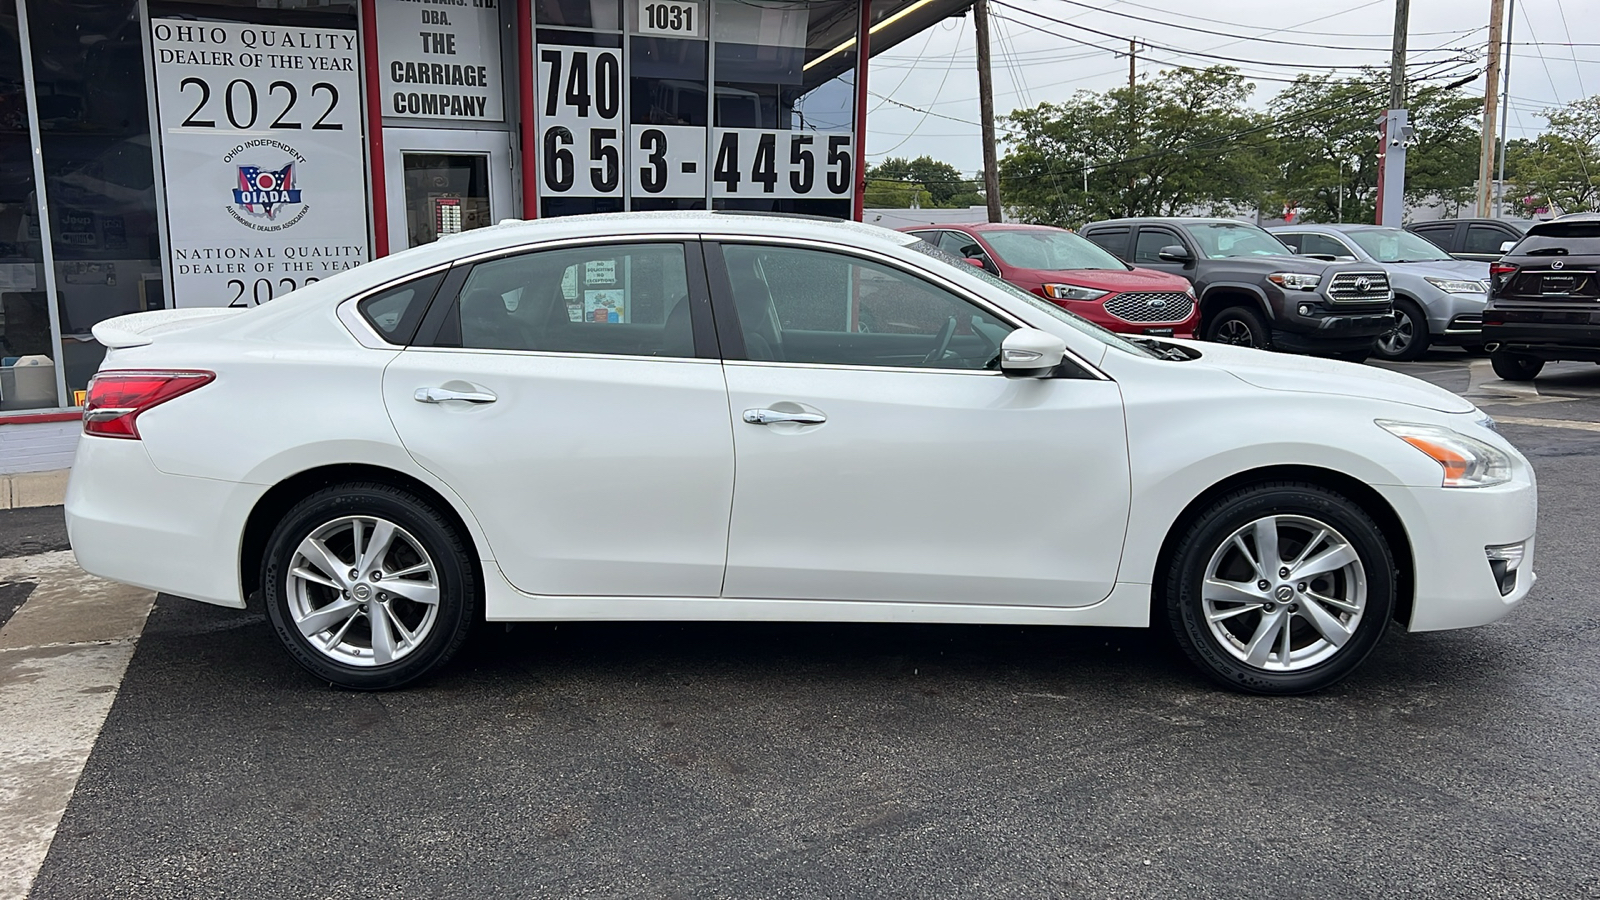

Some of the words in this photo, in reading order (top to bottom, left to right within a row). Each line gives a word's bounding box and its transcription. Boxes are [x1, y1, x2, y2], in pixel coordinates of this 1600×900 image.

[421, 9, 452, 26] DBA.
[645, 4, 693, 31] 1031
[154, 24, 227, 45] OHIO
[240, 29, 355, 50] QUALITY
[420, 31, 457, 55] THE
[159, 48, 235, 67] DEALER
[239, 53, 263, 68] OF
[267, 54, 304, 70] THE
[307, 56, 354, 72] YEAR
[390, 61, 488, 87] CARRIAGE
[541, 49, 620, 120] 740
[180, 77, 344, 130] 2022
[393, 91, 487, 117] COMPANY
[223, 145, 244, 163] OHIO
[244, 139, 307, 164] INDEPENDENT
[241, 190, 291, 203] OIADA
[225, 205, 257, 230] AUTOMOBILE
[282, 204, 310, 230] ASSOCIATION
[175, 247, 276, 260] NATIONAL
[284, 245, 364, 259] QUALITY
[179, 262, 247, 275] DEALER
[254, 262, 275, 273] OF
[281, 261, 314, 272] THE
[321, 260, 361, 271] YEAR
[226, 277, 321, 308] 20
[1185, 612, 1234, 675] SUREDRIVE
